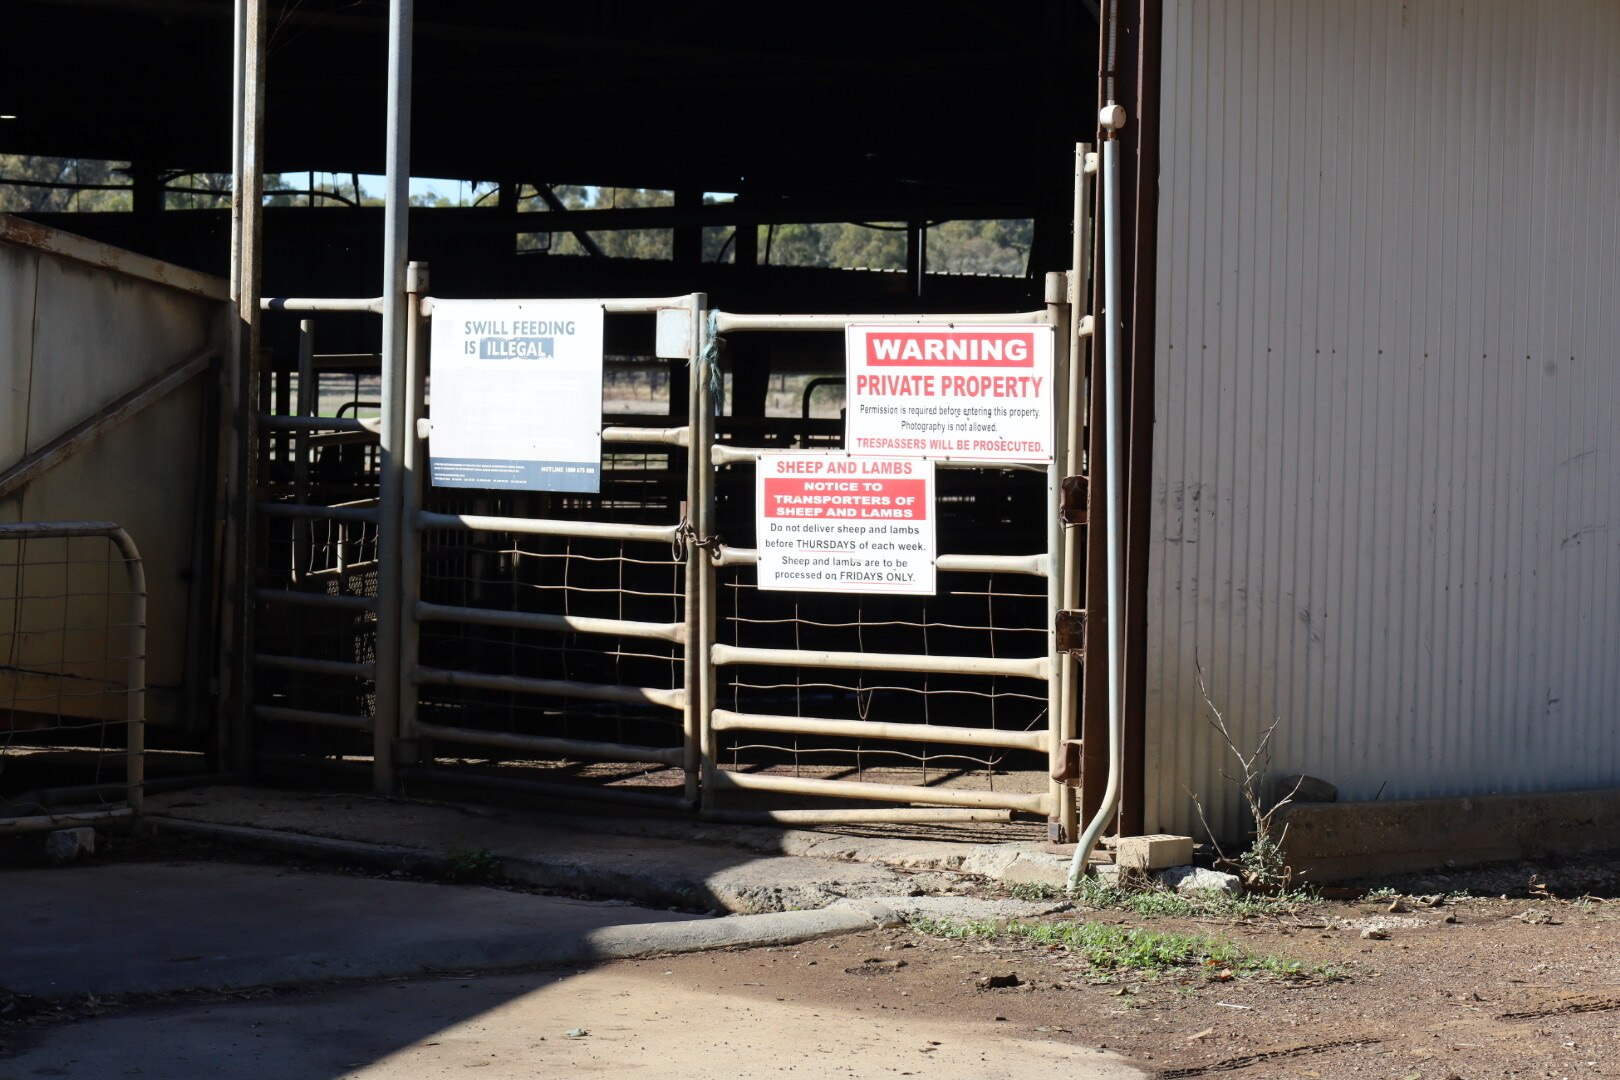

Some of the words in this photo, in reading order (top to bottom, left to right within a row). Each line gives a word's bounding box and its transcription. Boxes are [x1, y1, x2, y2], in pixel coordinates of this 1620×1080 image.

[465, 321, 508, 334] SWILL
[513, 321, 575, 335] FEEDING
[465, 341, 476, 354] IS
[488, 342, 545, 356] ILLEGAL
[873, 339, 1027, 361] WARNING
[857, 375, 934, 396] PRIVATE
[942, 376, 1042, 398] PROPERTY
[860, 405, 898, 414] Permission
[900, 405, 906, 414] is
[908, 405, 937, 415] required
[939, 406, 961, 415] before
[963, 407, 991, 418] entering
[994, 407, 1007, 416] this
[1009, 408, 1040, 418] property.
[901, 421, 945, 433] Photography
[947, 421, 953, 430] is
[956, 422, 967, 431] not
[969, 422, 997, 432] allowed.
[857, 438, 926, 449] TRESPASSERS
[930, 440, 953, 450] WILL
[957, 440, 969, 450] BE
[974, 440, 1043, 452] PROSECUTED.
[777, 461, 823, 474] SHEEP
[827, 462, 856, 474] AND
[862, 462, 912, 474] LAMBS
[804, 482, 858, 491] NOTICE
[863, 483, 882, 491] TO
[774, 495, 890, 505] TRANSPORTERS
[896, 497, 915, 505] OF
[776, 508, 822, 516] SHEEP
[826, 508, 856, 517] AND
[862, 509, 913, 518] LAMBS
[771, 523, 782, 532] Do
[786, 524, 800, 532] not
[803, 524, 834, 532] deliver
[838, 525, 865, 535] sheep
[869, 525, 886, 533] and
[890, 526, 919, 534] lambs
[766, 539, 793, 548] before
[797, 540, 855, 549] THURSDAYS
[859, 540, 868, 549] of
[871, 541, 894, 550] each
[898, 542, 926, 550] week.
[782, 556, 809, 566] Sheep
[813, 557, 829, 565] and
[833, 557, 861, 566] lambs
[883, 559, 892, 567] to
[896, 559, 907, 567] be
[775, 571, 822, 580] processed
[840, 572, 882, 581] FRIDAYS
[886, 573, 915, 582] ONLY.
